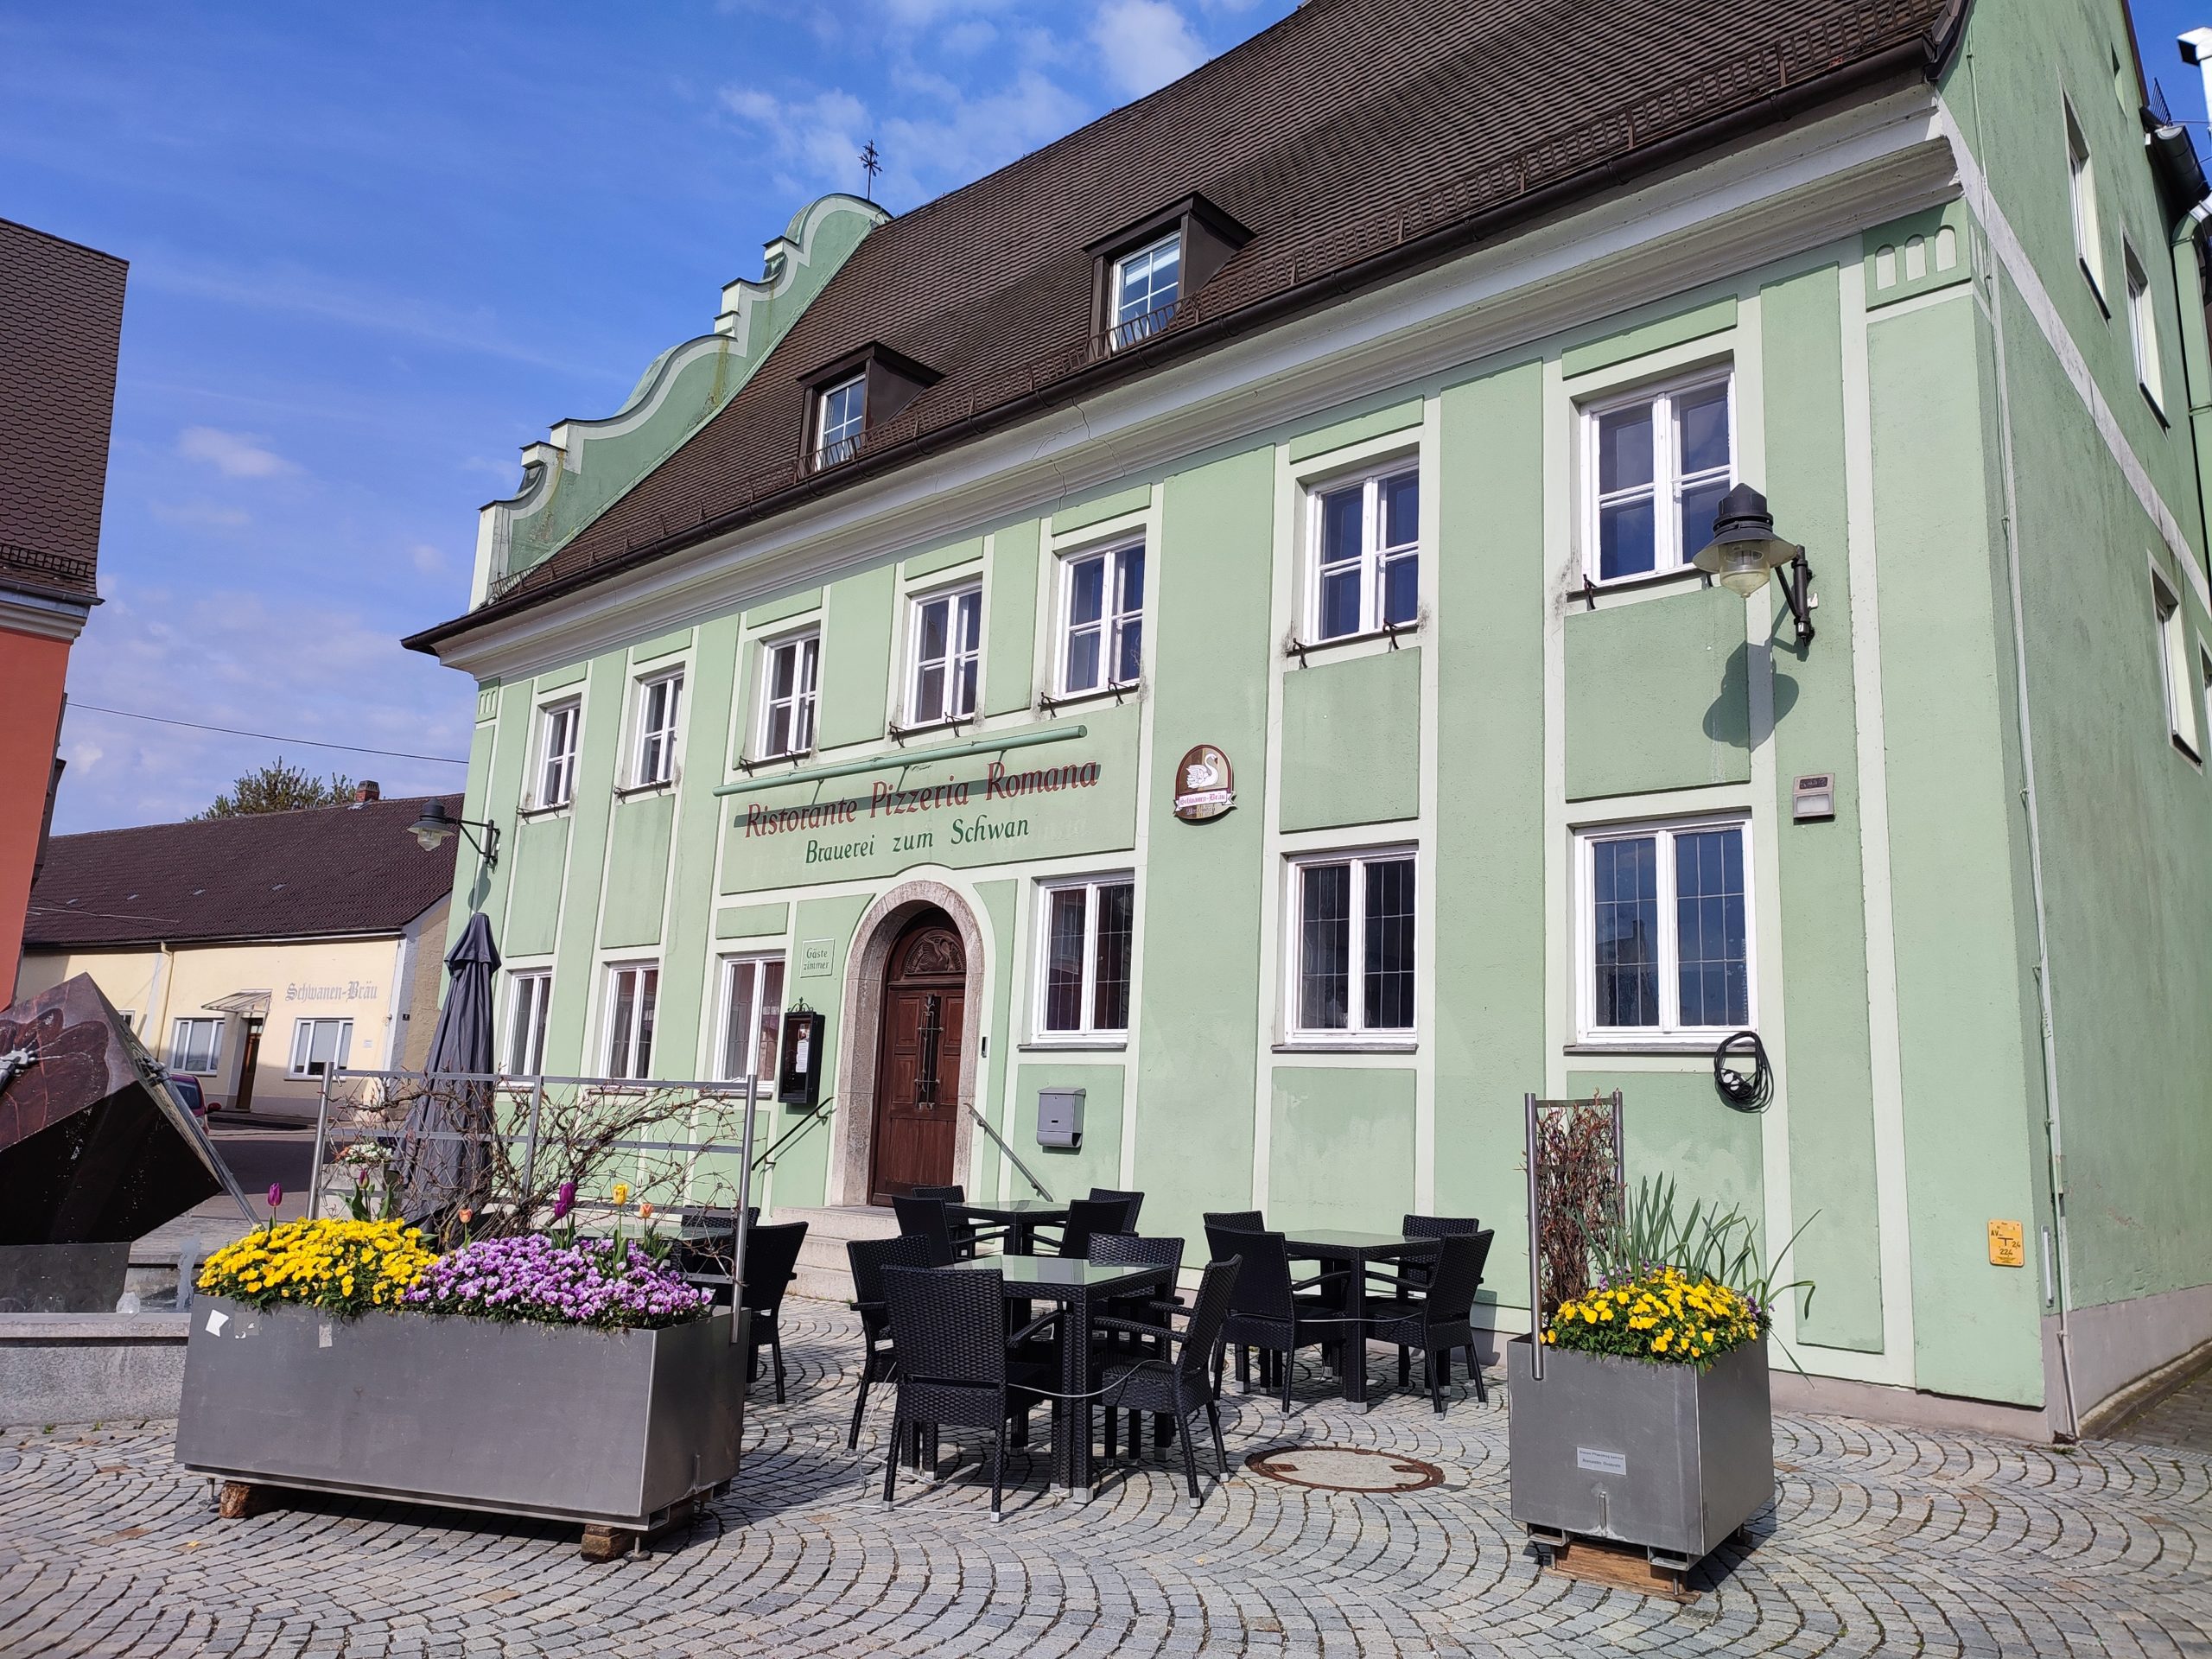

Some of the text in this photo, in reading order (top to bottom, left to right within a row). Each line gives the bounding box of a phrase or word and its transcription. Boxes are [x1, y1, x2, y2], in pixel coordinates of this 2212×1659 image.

[746, 761, 1098, 838] Ristorante Pizzeria Romana
[805, 814, 1029, 864] Brauerei zum Schwan
[806, 947, 828, 959] Gäste
[804, 961, 830, 970] zimmer
[285, 981, 378, 1003] Schwanen-Bräu
